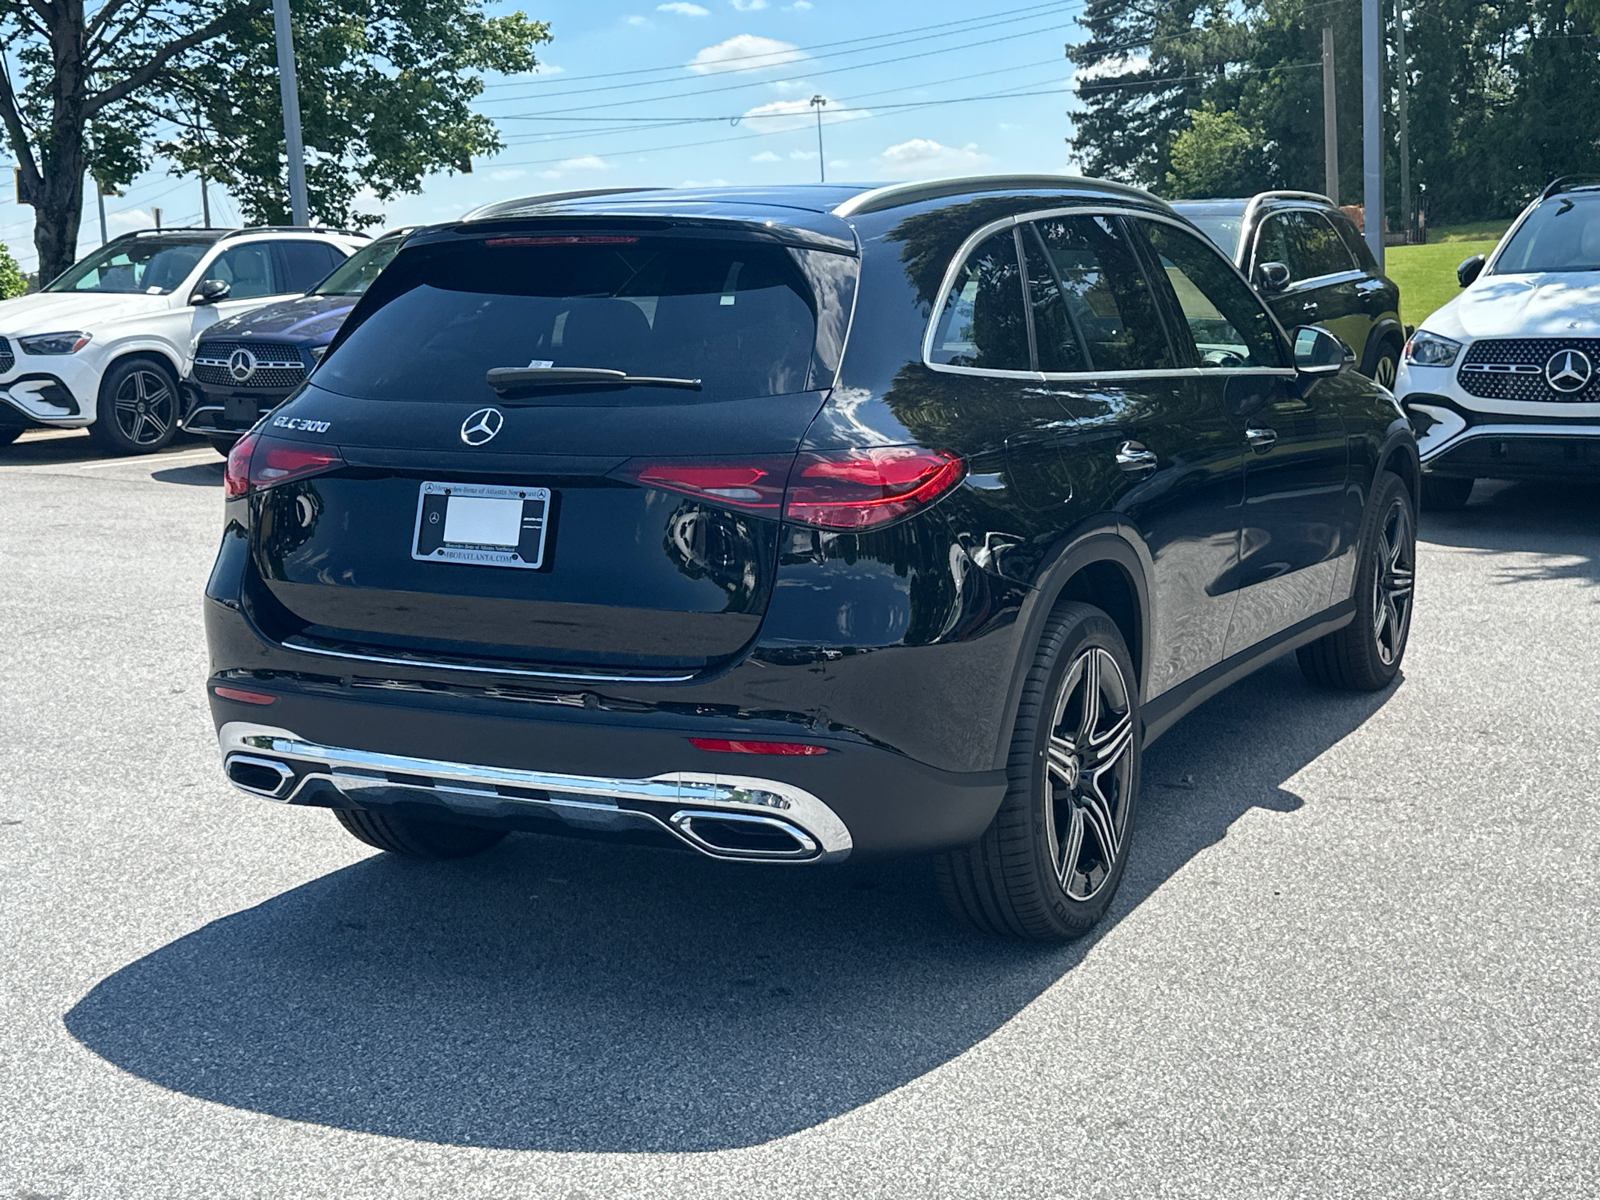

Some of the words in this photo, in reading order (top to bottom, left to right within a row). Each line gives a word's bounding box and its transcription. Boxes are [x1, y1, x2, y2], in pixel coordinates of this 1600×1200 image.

[273, 416, 301, 429] GLC
[297, 419, 331, 433] 300
[486, 488, 507, 496] Atlanta
